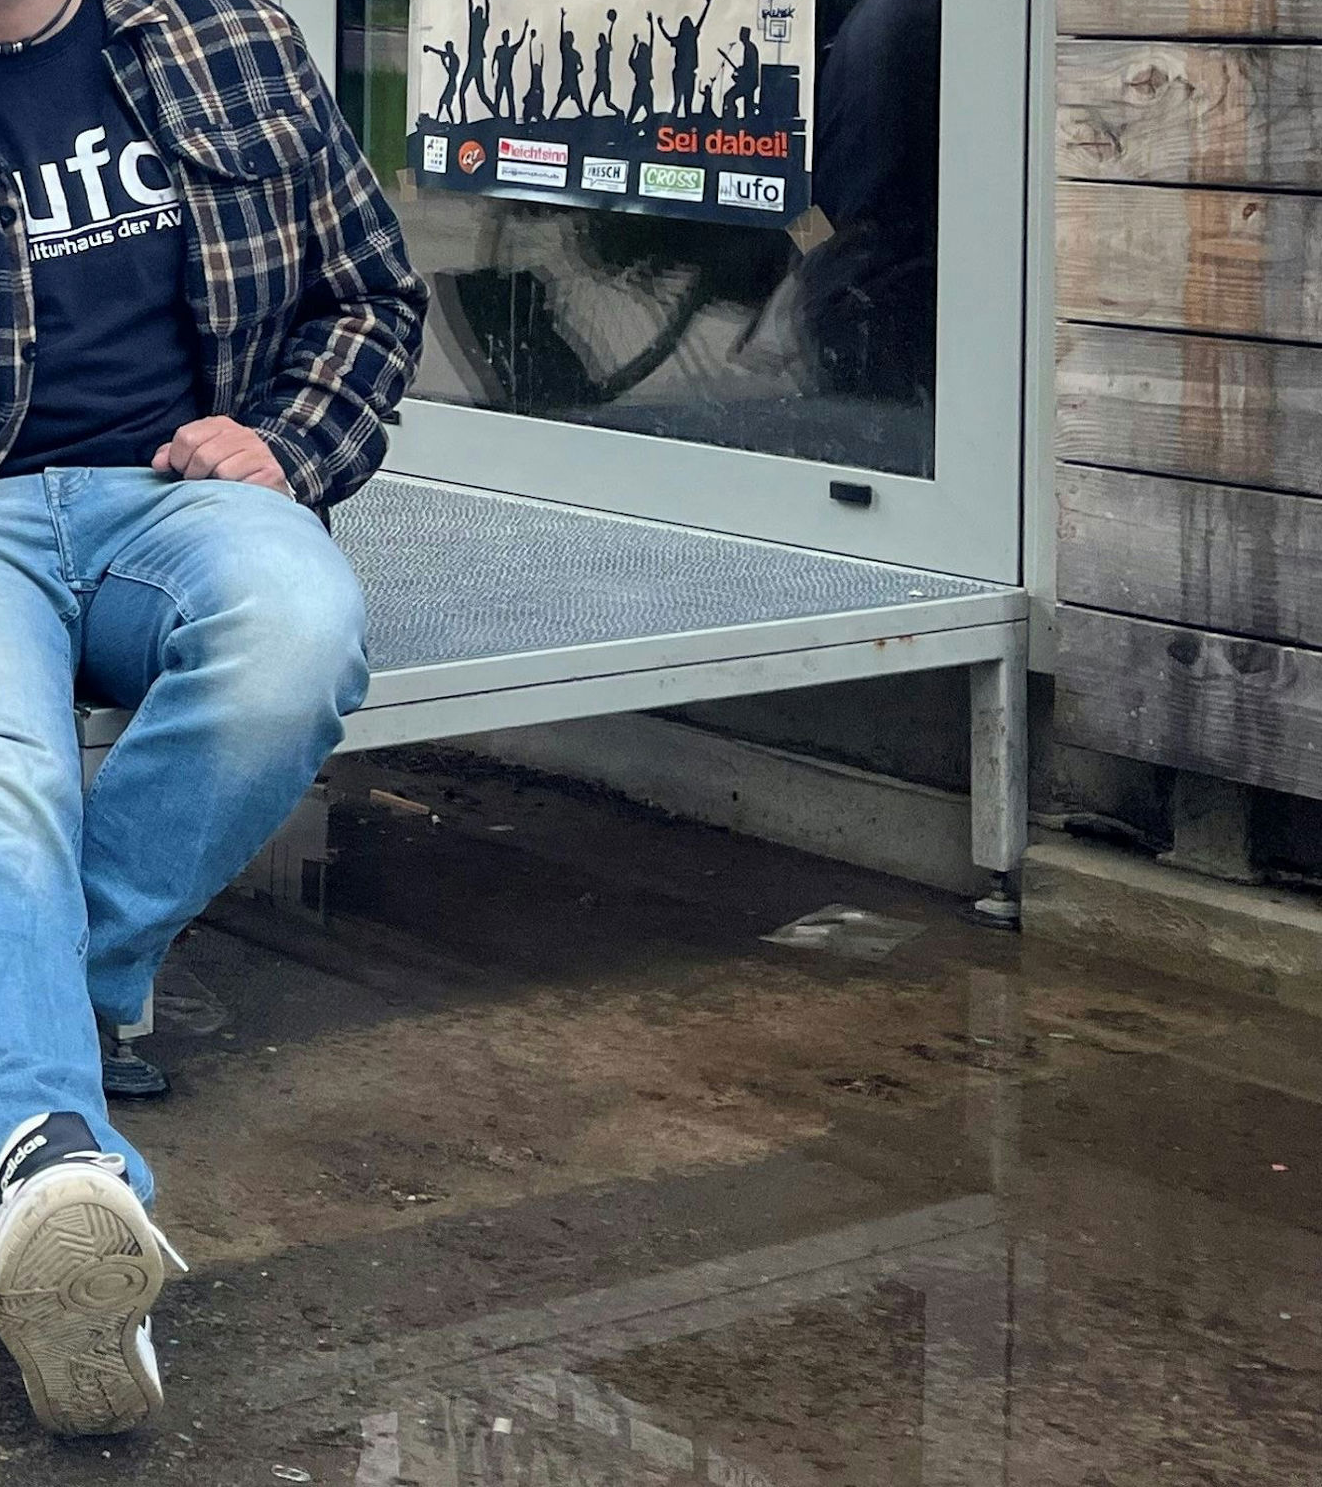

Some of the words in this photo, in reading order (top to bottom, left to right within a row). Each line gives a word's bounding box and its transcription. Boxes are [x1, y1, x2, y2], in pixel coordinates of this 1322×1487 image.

[510, 143, 567, 162] leichtsinn
[657, 126, 698, 153] Sei
[704, 128, 789, 159] dabei!
[12, 125, 178, 235] ufo
[647, 168, 698, 188] CROSS
[737, 177, 779, 202] ufo
[117, 219, 151, 238] der
